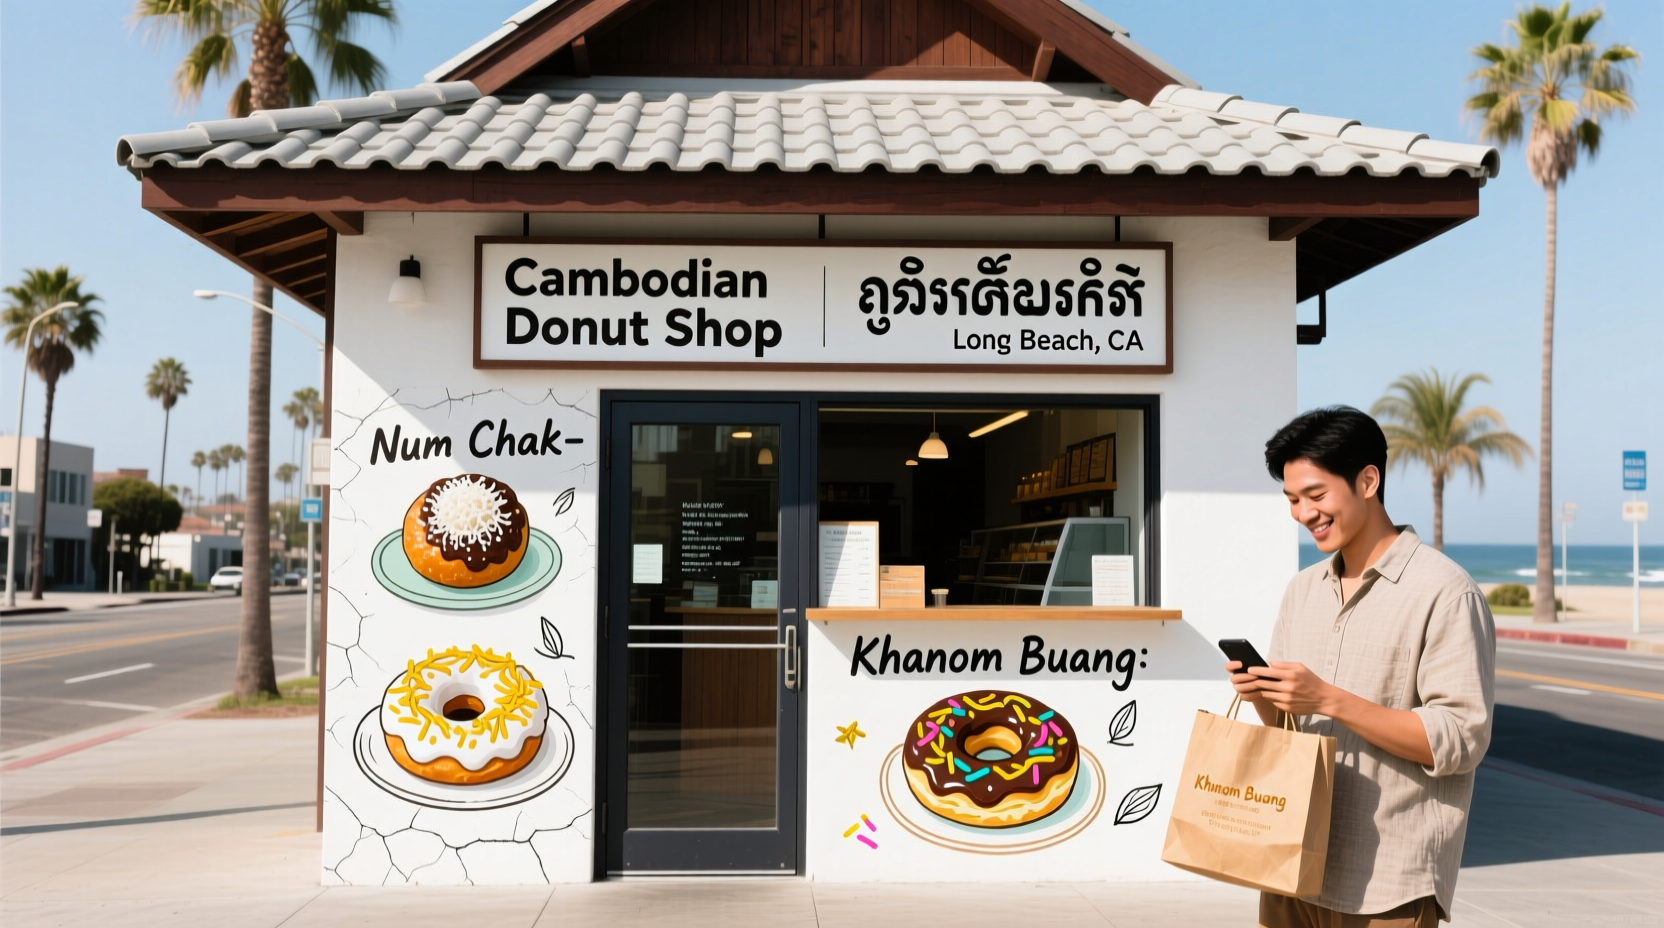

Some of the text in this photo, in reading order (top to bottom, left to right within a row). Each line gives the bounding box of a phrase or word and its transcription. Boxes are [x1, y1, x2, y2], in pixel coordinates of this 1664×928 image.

[504, 257, 768, 299] Cambodian
[506, 306, 783, 358] Donut Shop
[953, 328, 1144, 355] Long Beach, CA
[370, 418, 584, 466] Num Chak-
[850, 633, 1148, 692] Khanom Buang:
[1244, 785, 1287, 813] Buang
